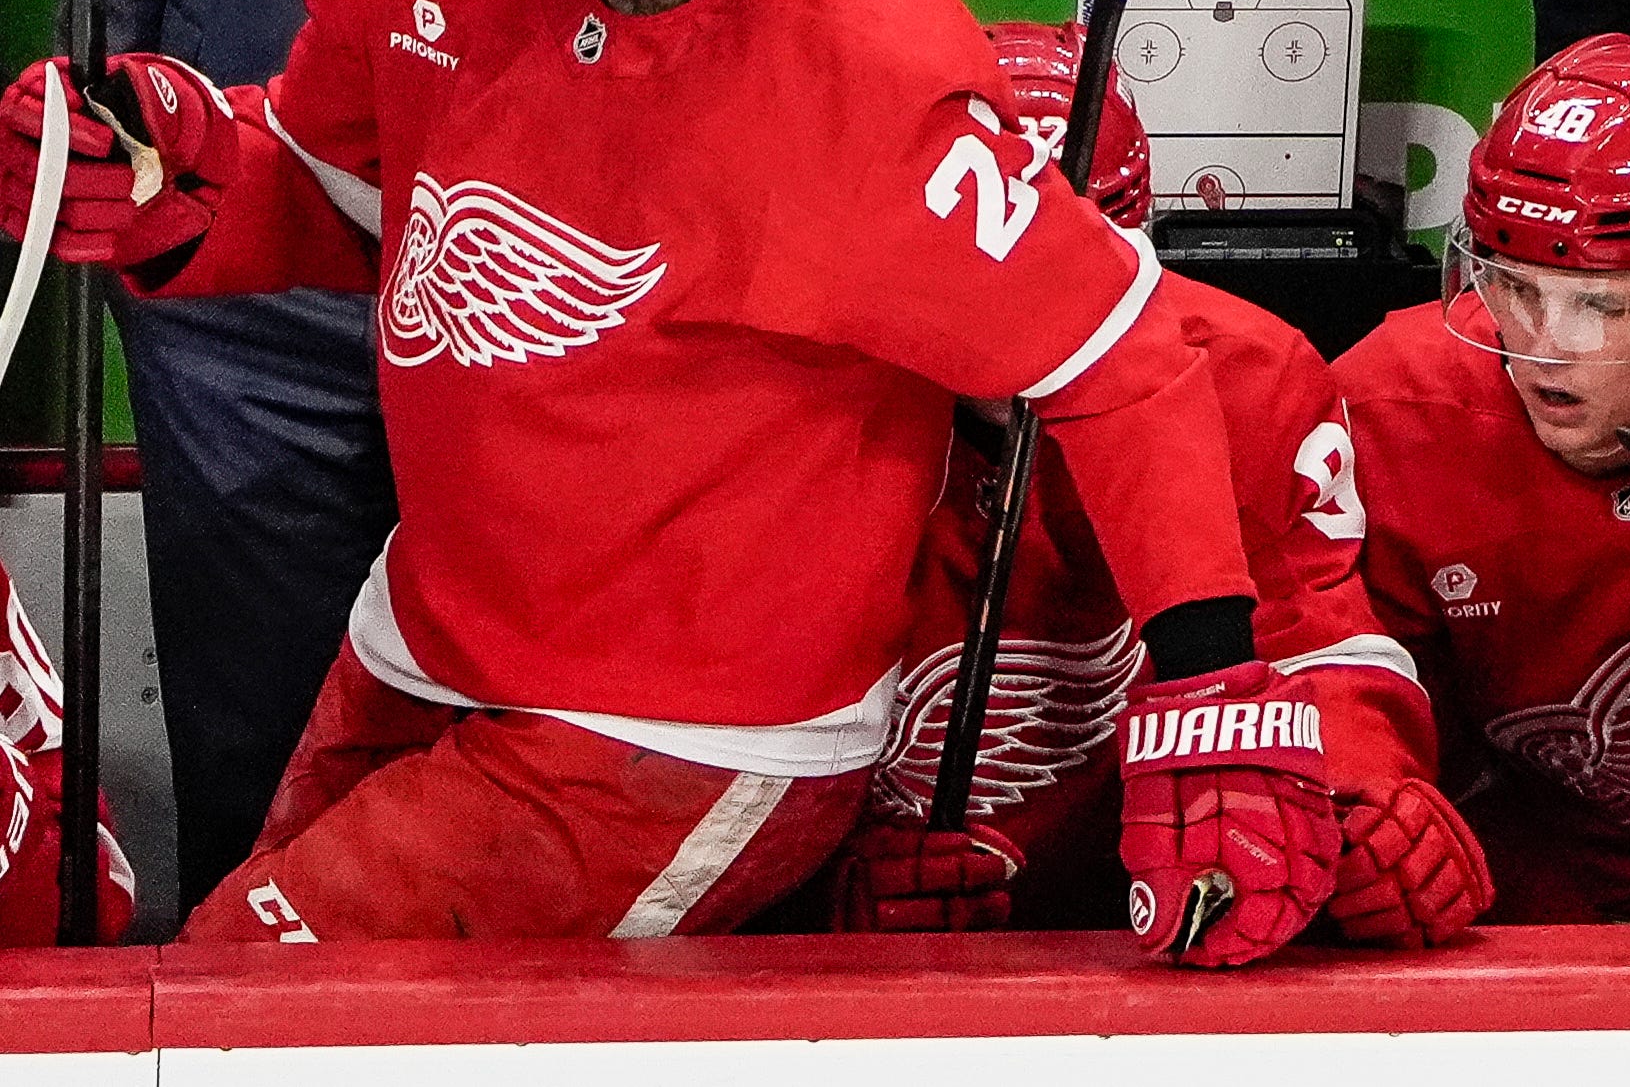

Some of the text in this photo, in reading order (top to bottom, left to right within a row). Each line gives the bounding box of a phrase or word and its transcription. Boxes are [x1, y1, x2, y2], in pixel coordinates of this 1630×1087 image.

[389, 32, 460, 71] PRIORITY
[1533, 97, 1598, 143] 48
[1496, 195, 1578, 225] CCM
[1442, 600, 1502, 619] ORITY
[1126, 700, 1324, 765] WARRIO
